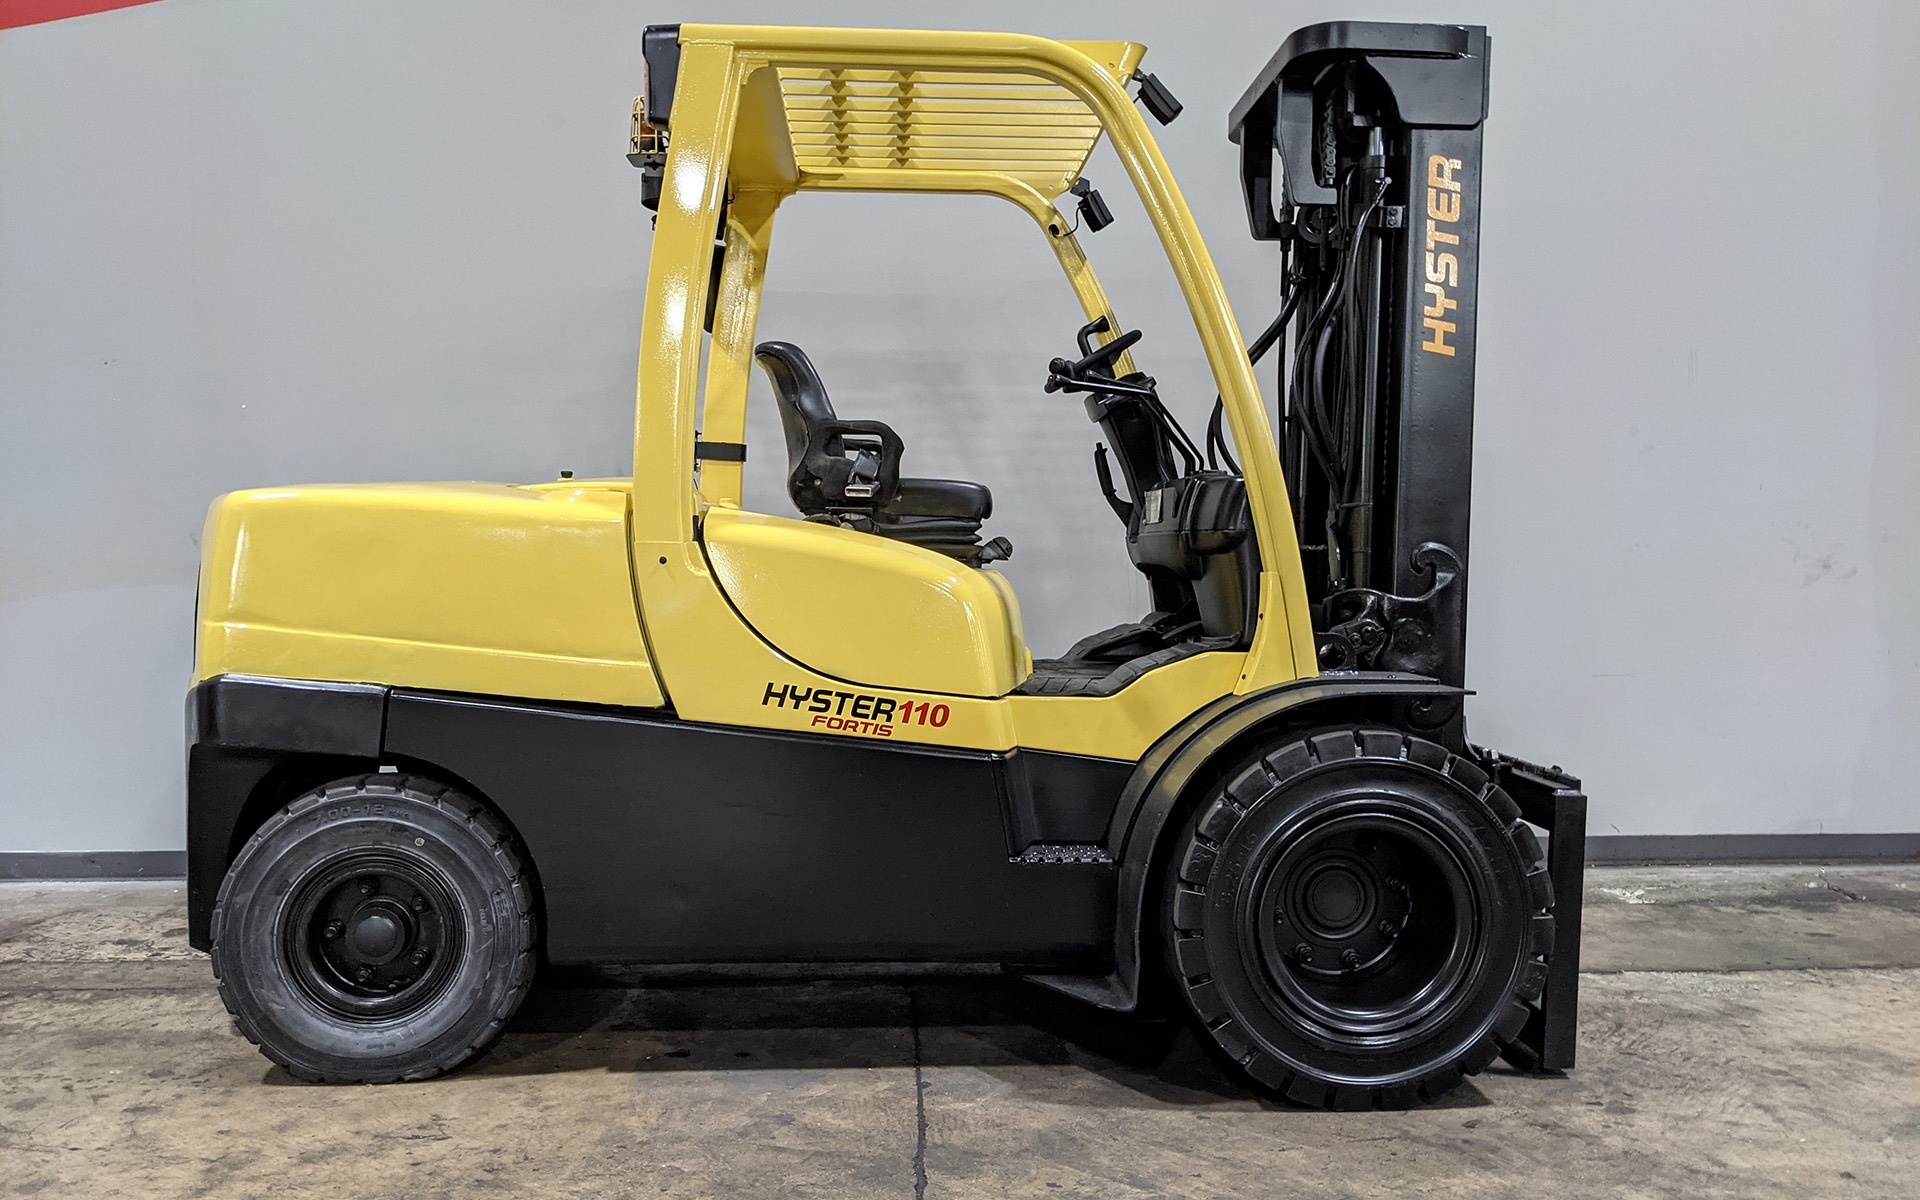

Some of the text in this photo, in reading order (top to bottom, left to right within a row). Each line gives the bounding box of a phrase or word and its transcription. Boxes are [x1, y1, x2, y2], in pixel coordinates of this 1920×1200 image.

[1422, 154, 1462, 357] HYSTER
[761, 682, 950, 728] HYSTER 110
[811, 715, 893, 737] FORTIS
